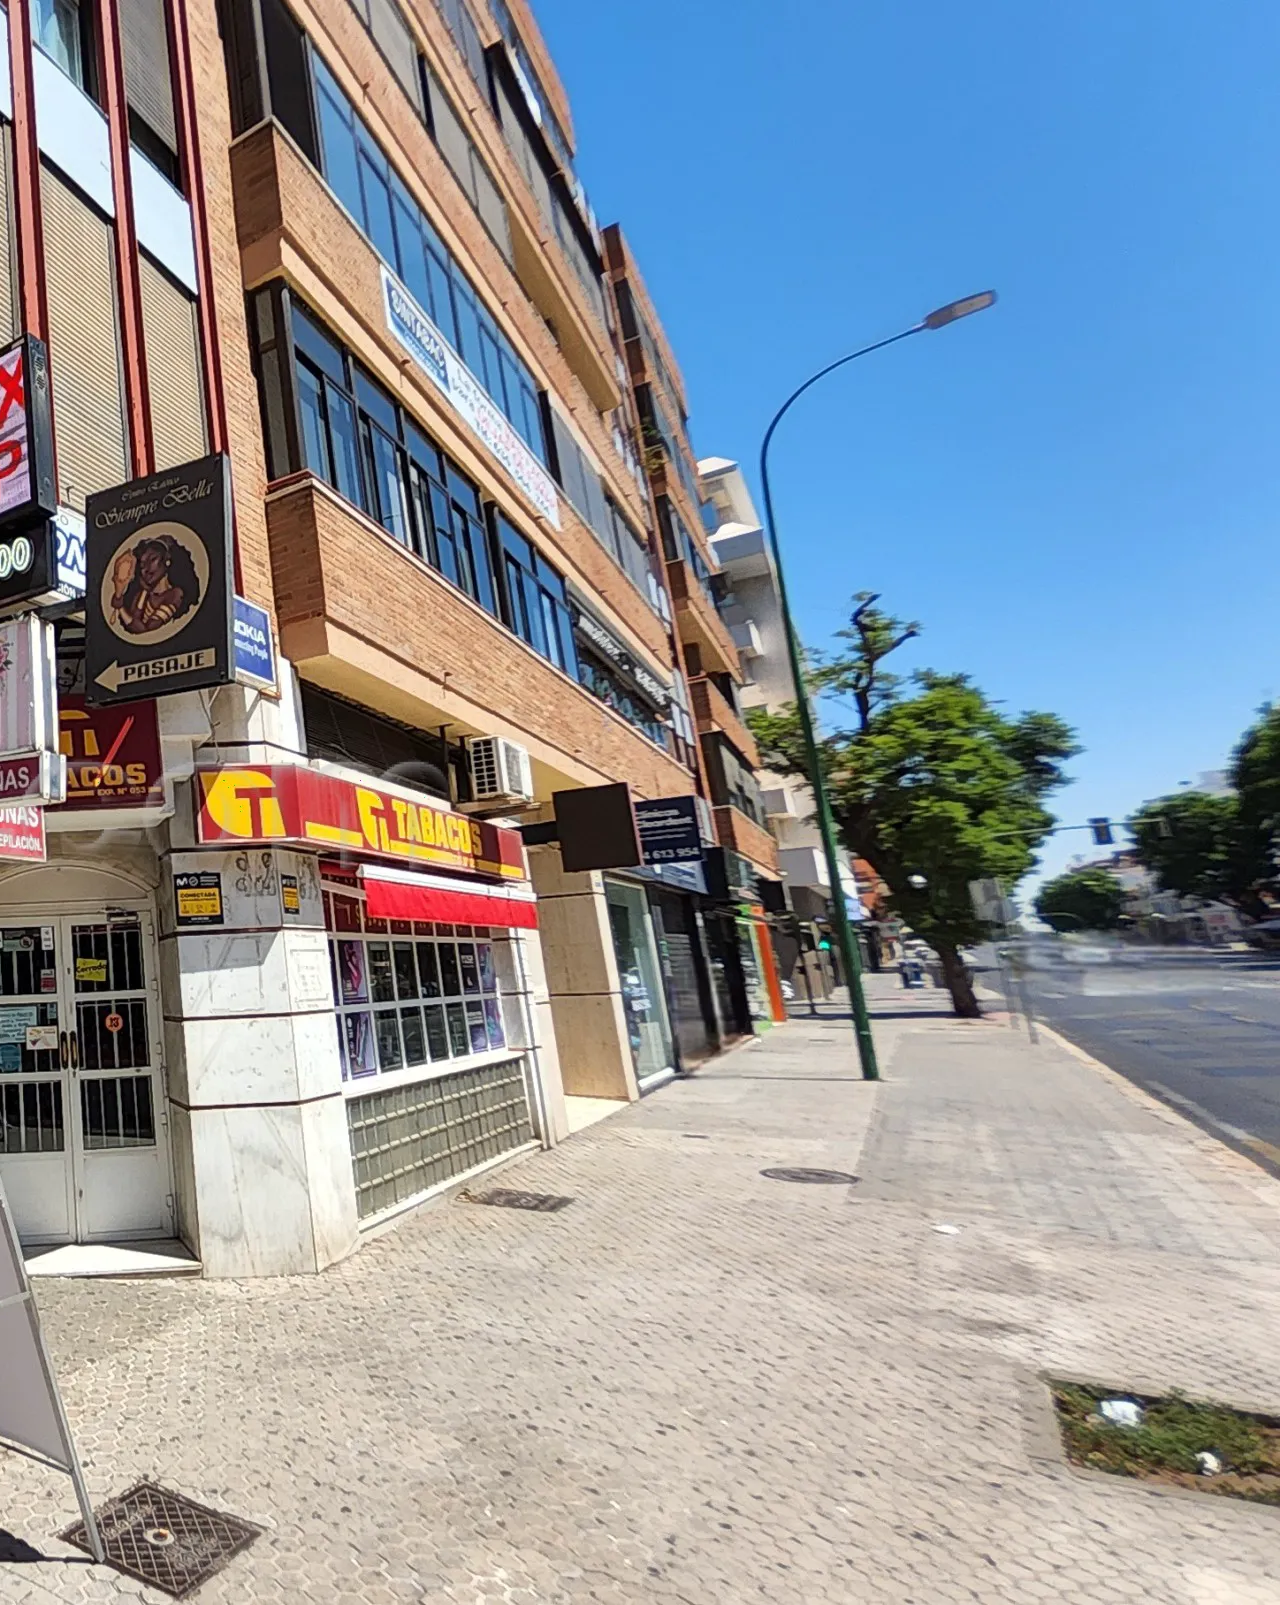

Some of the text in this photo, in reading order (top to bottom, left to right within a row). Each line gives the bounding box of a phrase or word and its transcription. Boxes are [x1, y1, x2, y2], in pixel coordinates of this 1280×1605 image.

[95, 500, 158, 529] Siempre
[123, 652, 205, 681] PASAJE
[392, 799, 483, 857] TABACOS
